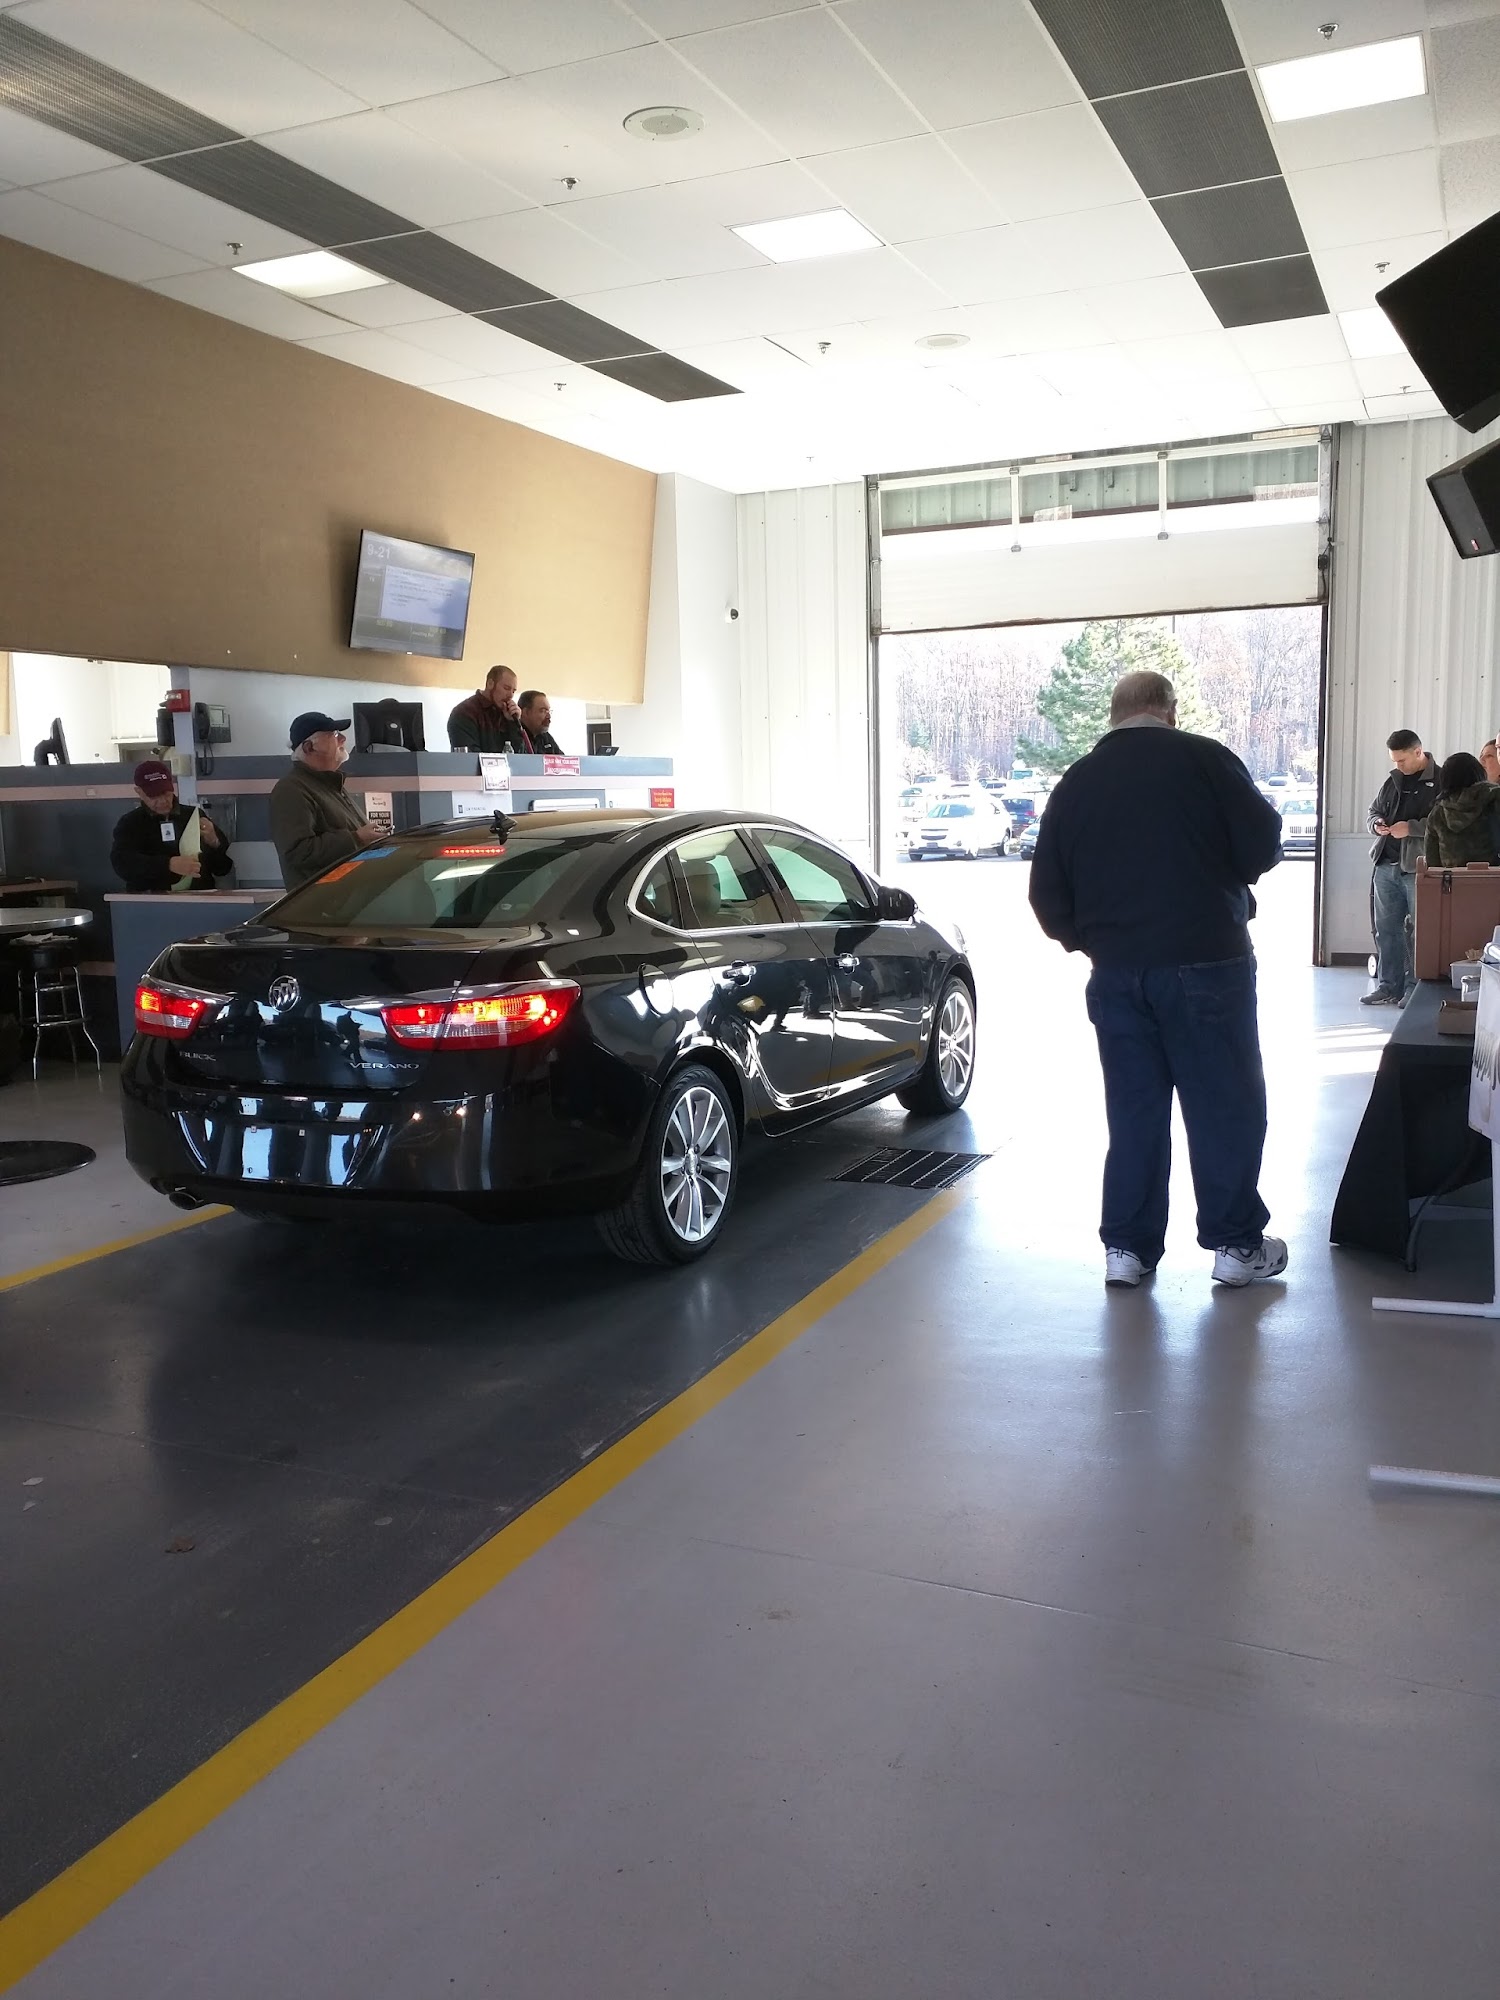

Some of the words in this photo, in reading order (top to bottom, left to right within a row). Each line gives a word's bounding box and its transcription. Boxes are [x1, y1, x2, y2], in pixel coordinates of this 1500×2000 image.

[367, 543, 391, 560] 9-21
[179, 1051, 217, 1062] BUICK
[349, 1062, 420, 1070] VERANO
